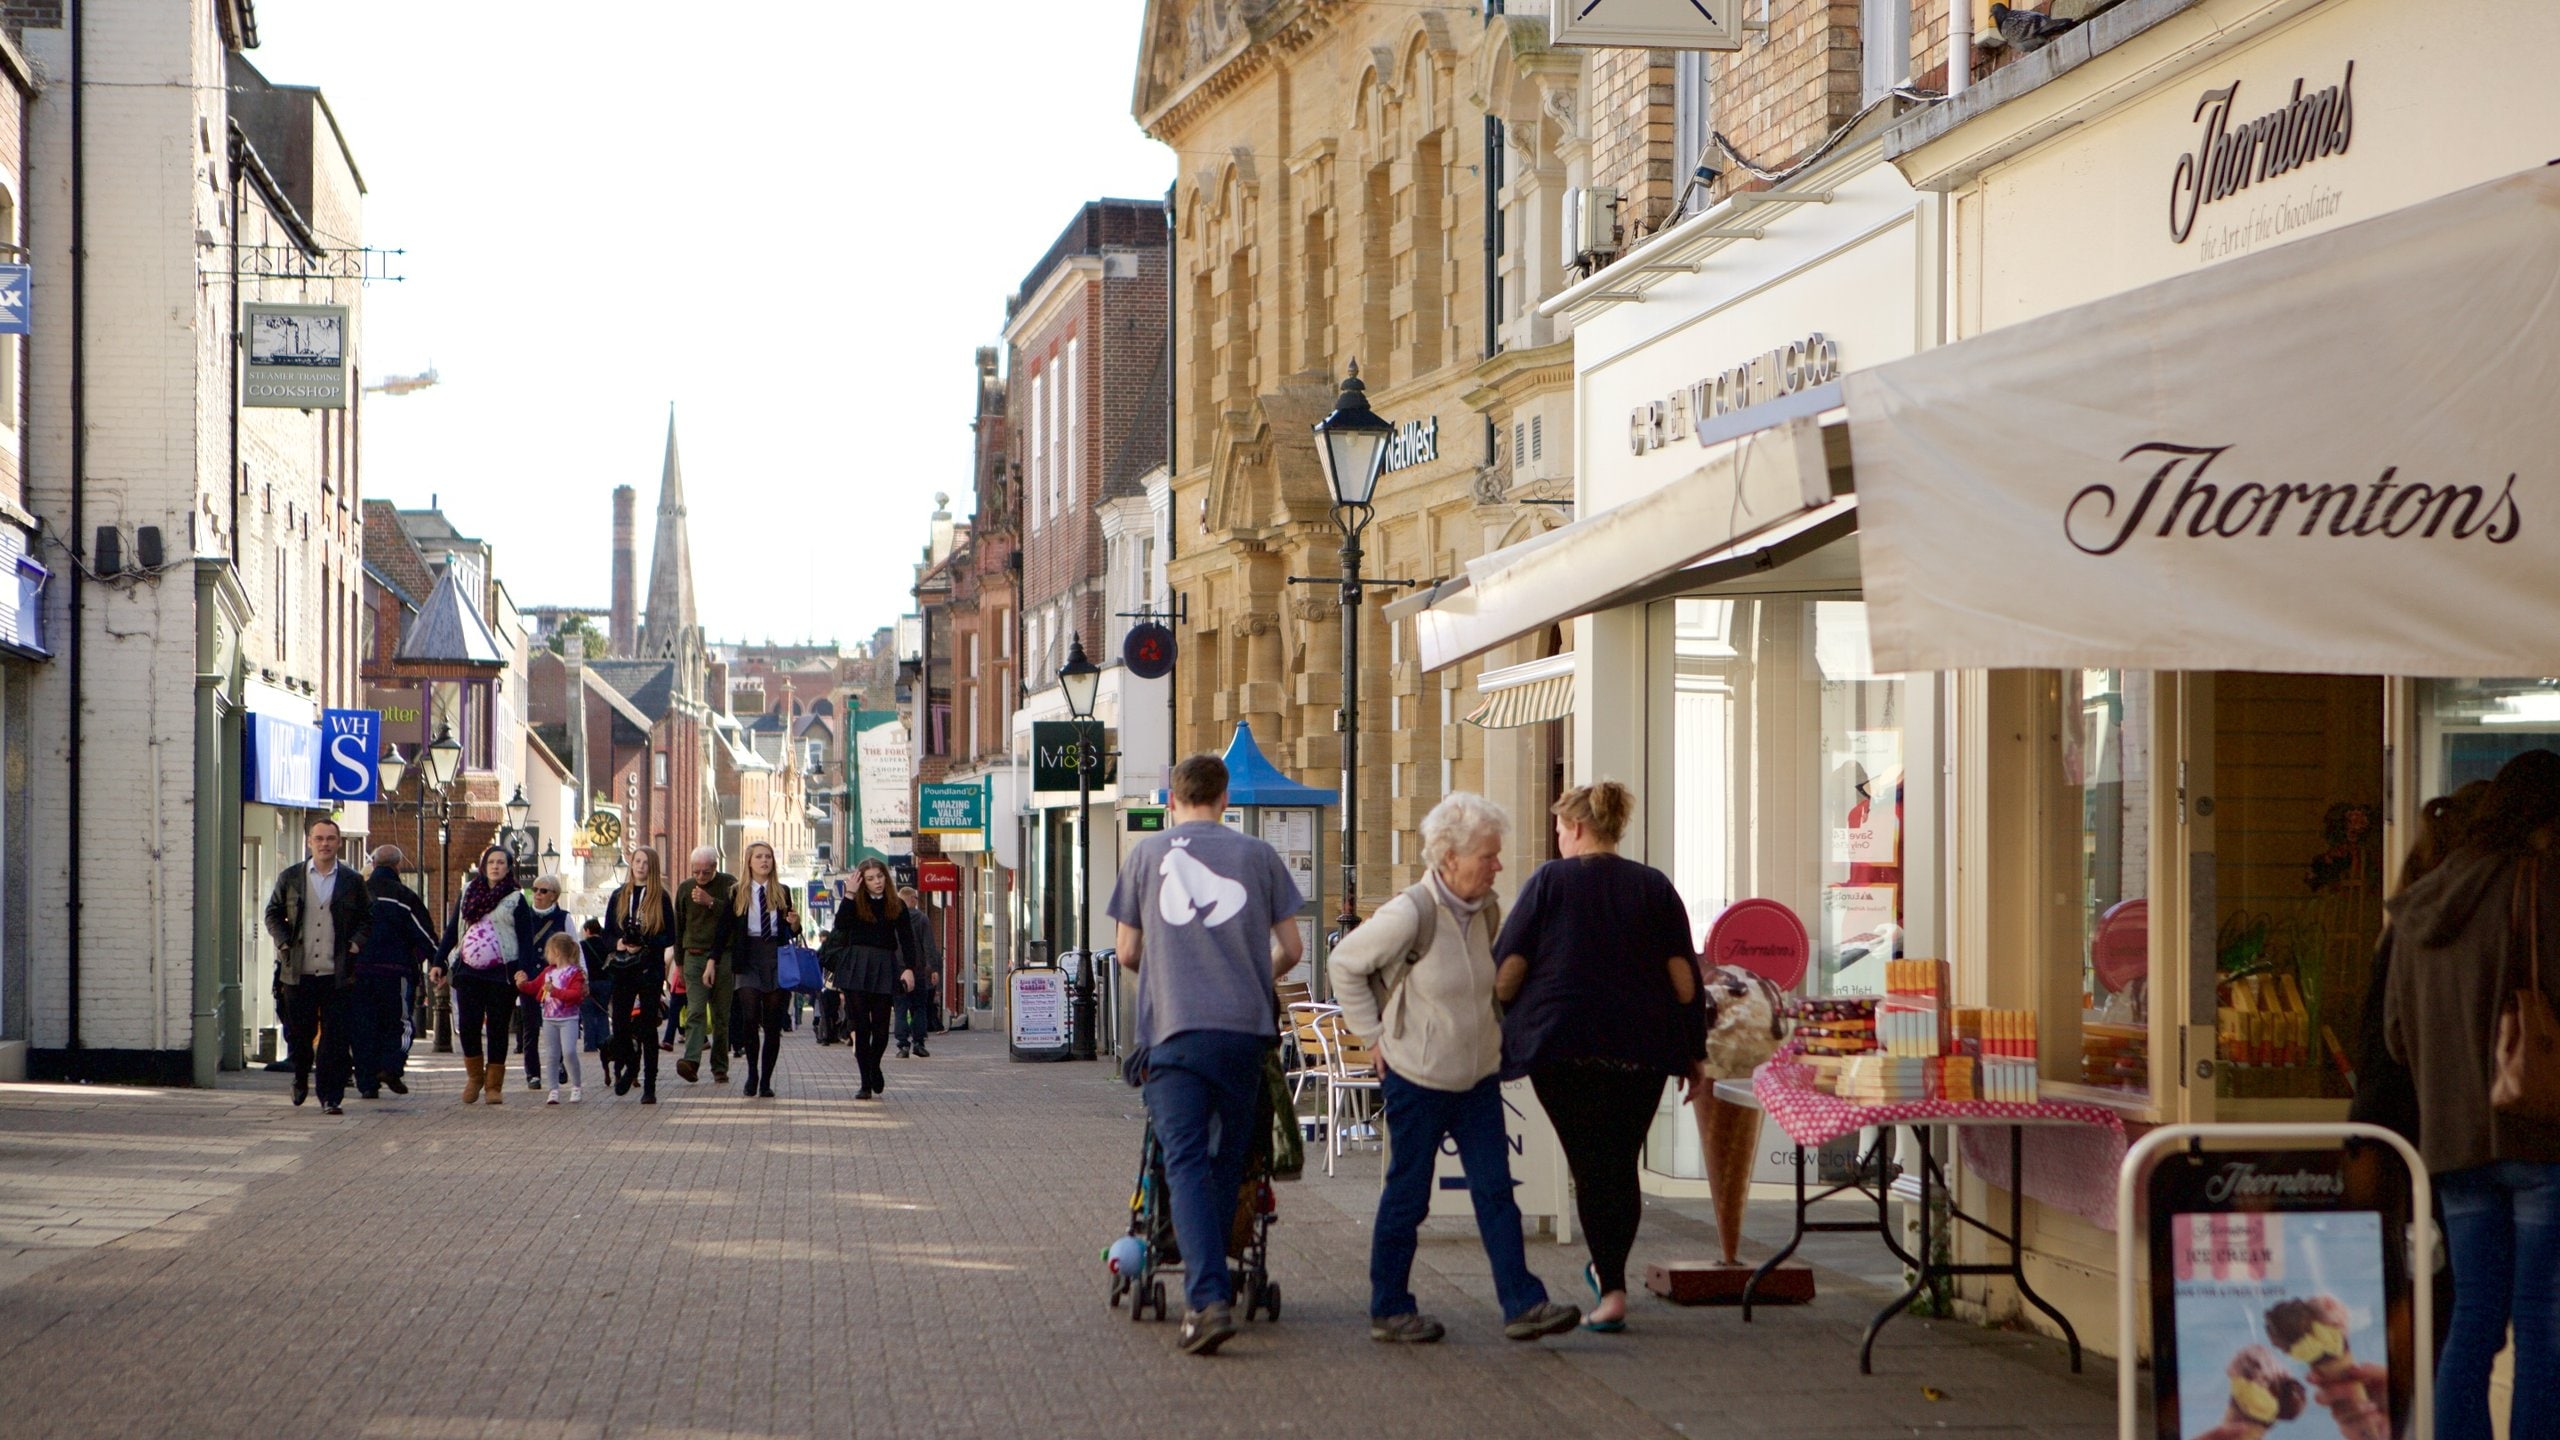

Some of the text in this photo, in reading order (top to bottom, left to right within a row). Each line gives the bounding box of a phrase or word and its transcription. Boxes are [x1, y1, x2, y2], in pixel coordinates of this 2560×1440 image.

[2169, 59, 2354, 244] Thorntons
[2200, 184, 2343, 263] the Art of the Chocolatier
[249, 371, 340, 381] STEAMER TRADING
[249, 385, 340, 397] COOKSHOP
[1630, 378, 1714, 456] CREW
[1385, 416, 1437, 473] NatWest
[2063, 441, 2522, 556] Thorntons
[368, 704, 421, 722] otter
[331, 716, 370, 735] WH
[329, 734, 370, 795] S
[924, 787, 967, 795] Poundland
[629, 772, 638, 852] GOULDS
[932, 800, 970, 809] AMAZING
[937, 808, 964, 817] VALUE
[929, 817, 972, 826] EVERYDAY
[899, 873, 911, 882] W
[1724, 939, 1796, 960] Thorntons
[2204, 1162, 2345, 1204] Thorntons
